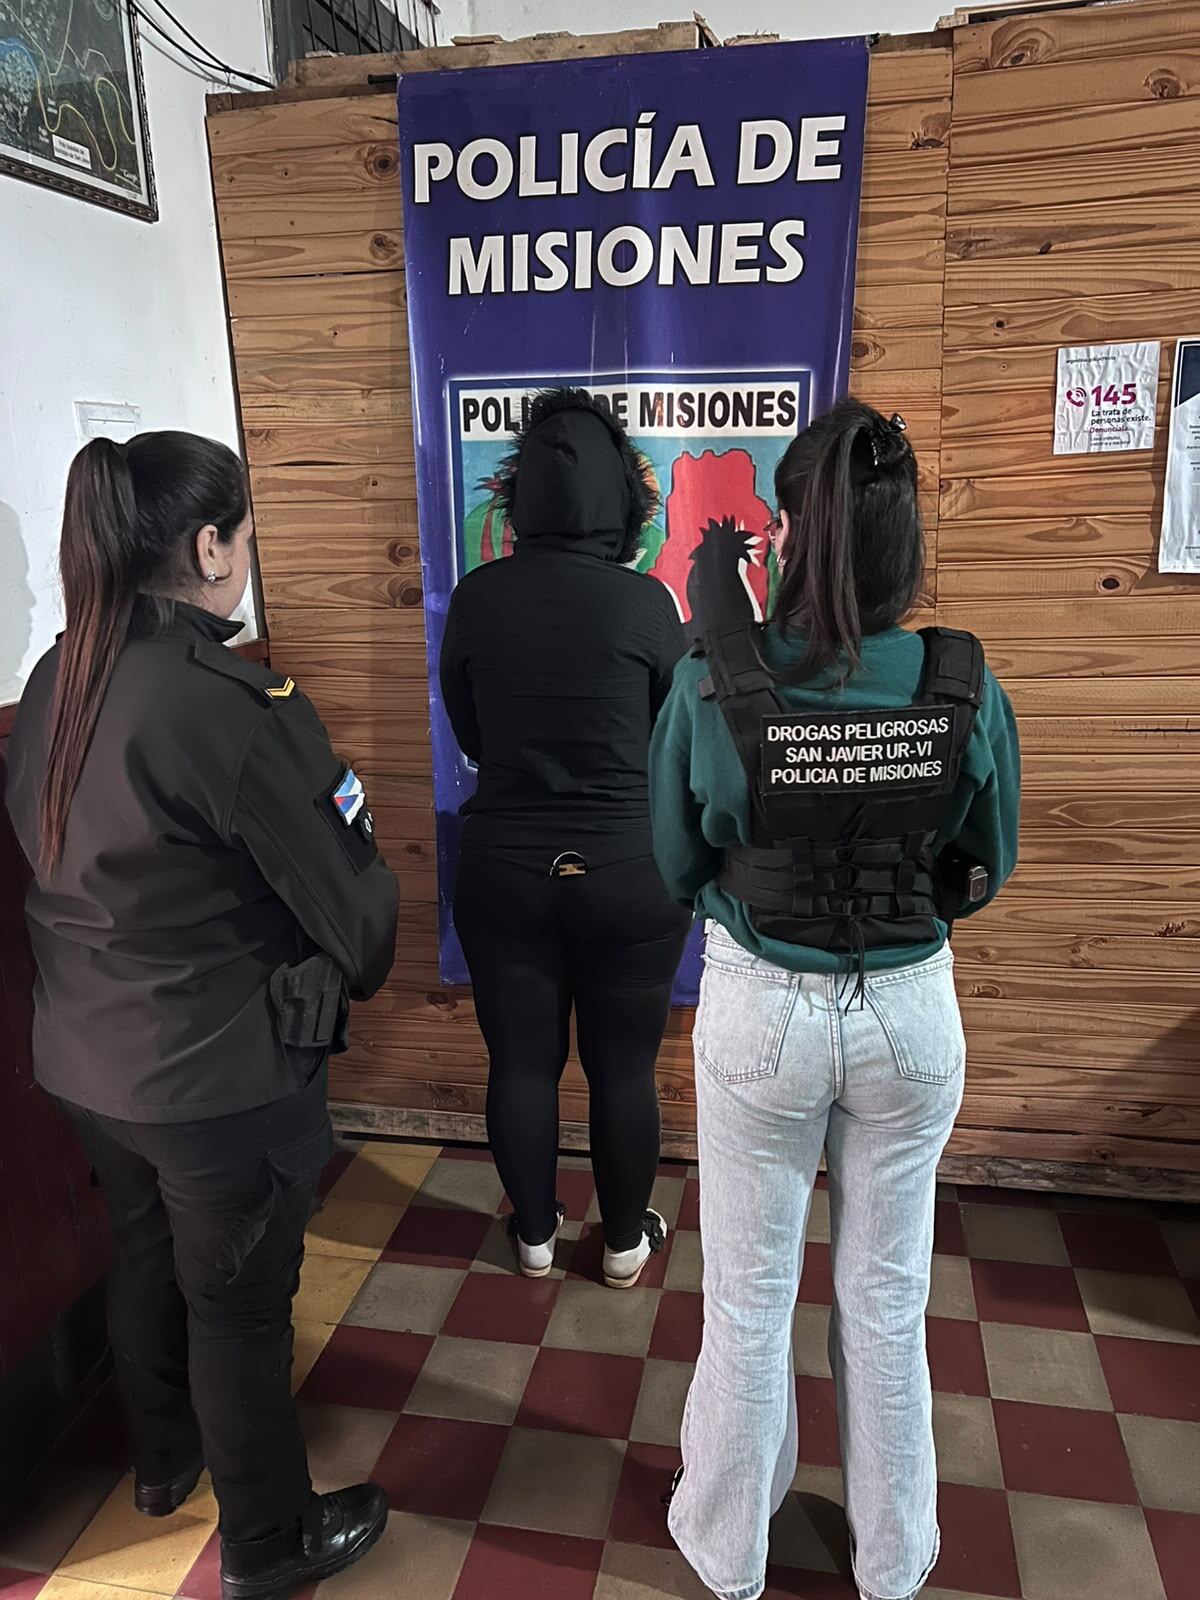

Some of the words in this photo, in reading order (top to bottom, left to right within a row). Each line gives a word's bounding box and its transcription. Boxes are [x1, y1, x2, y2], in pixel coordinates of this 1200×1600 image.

[413, 111, 716, 204] POLICÍA
[736, 115, 847, 186] DE
[447, 219, 806, 296] MISIONES
[1091, 383, 1137, 406] 145
[639, 390, 796, 429] MISIONES
[1090, 417, 1125, 426] personas
[1126, 414, 1152, 422] existe.
[1102, 408, 1121, 416] trata
[1122, 407, 1132, 416] de
[767, 724, 842, 742] DROGAS
[844, 716, 949, 741] PELIGROSAS
[785, 746, 822, 763] SAN
[825, 744, 884, 764] JAVIER
[886, 740, 932, 760] UR-VI
[770, 767, 839, 784] POLICIA
[842, 766, 866, 784] DE
[869, 760, 942, 783] MISIONES
